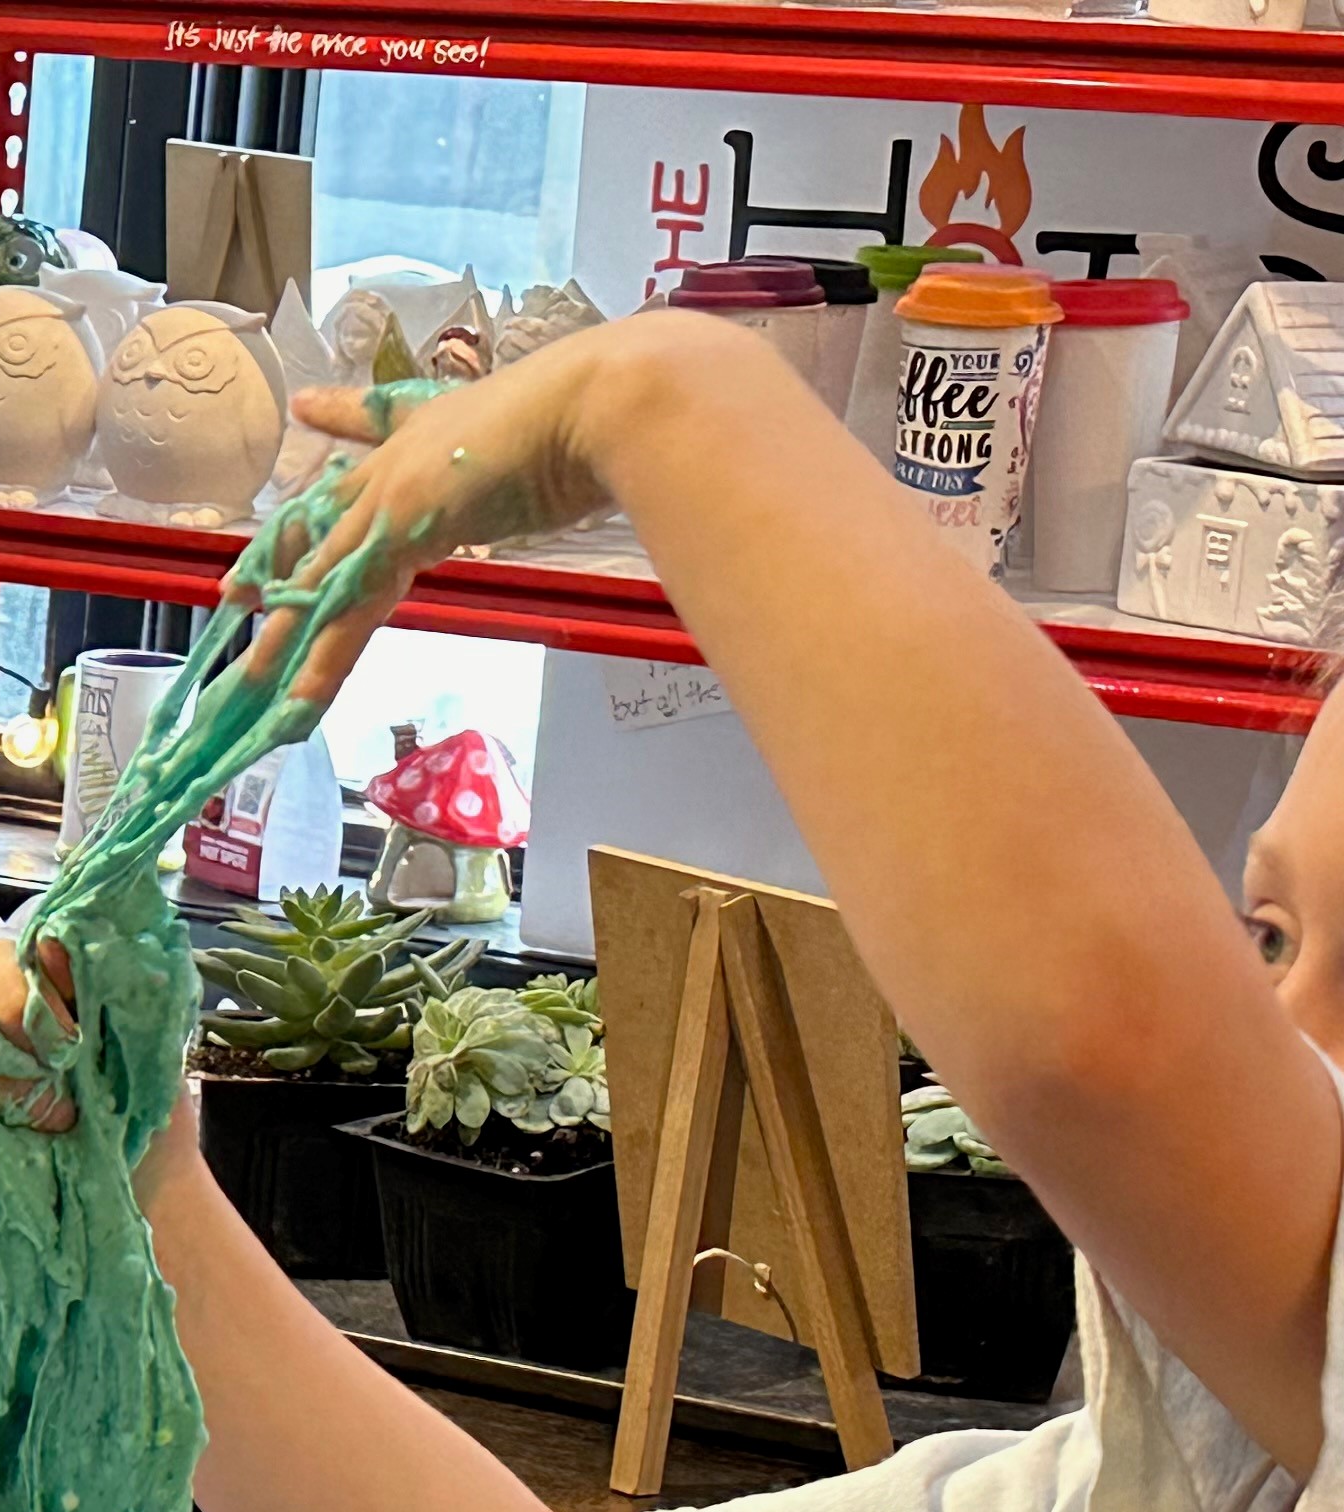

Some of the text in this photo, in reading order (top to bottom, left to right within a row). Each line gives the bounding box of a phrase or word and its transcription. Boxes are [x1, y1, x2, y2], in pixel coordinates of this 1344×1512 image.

[164, 20, 491, 69] It's just the price you see!
[898, 428, 993, 464] STRONG
